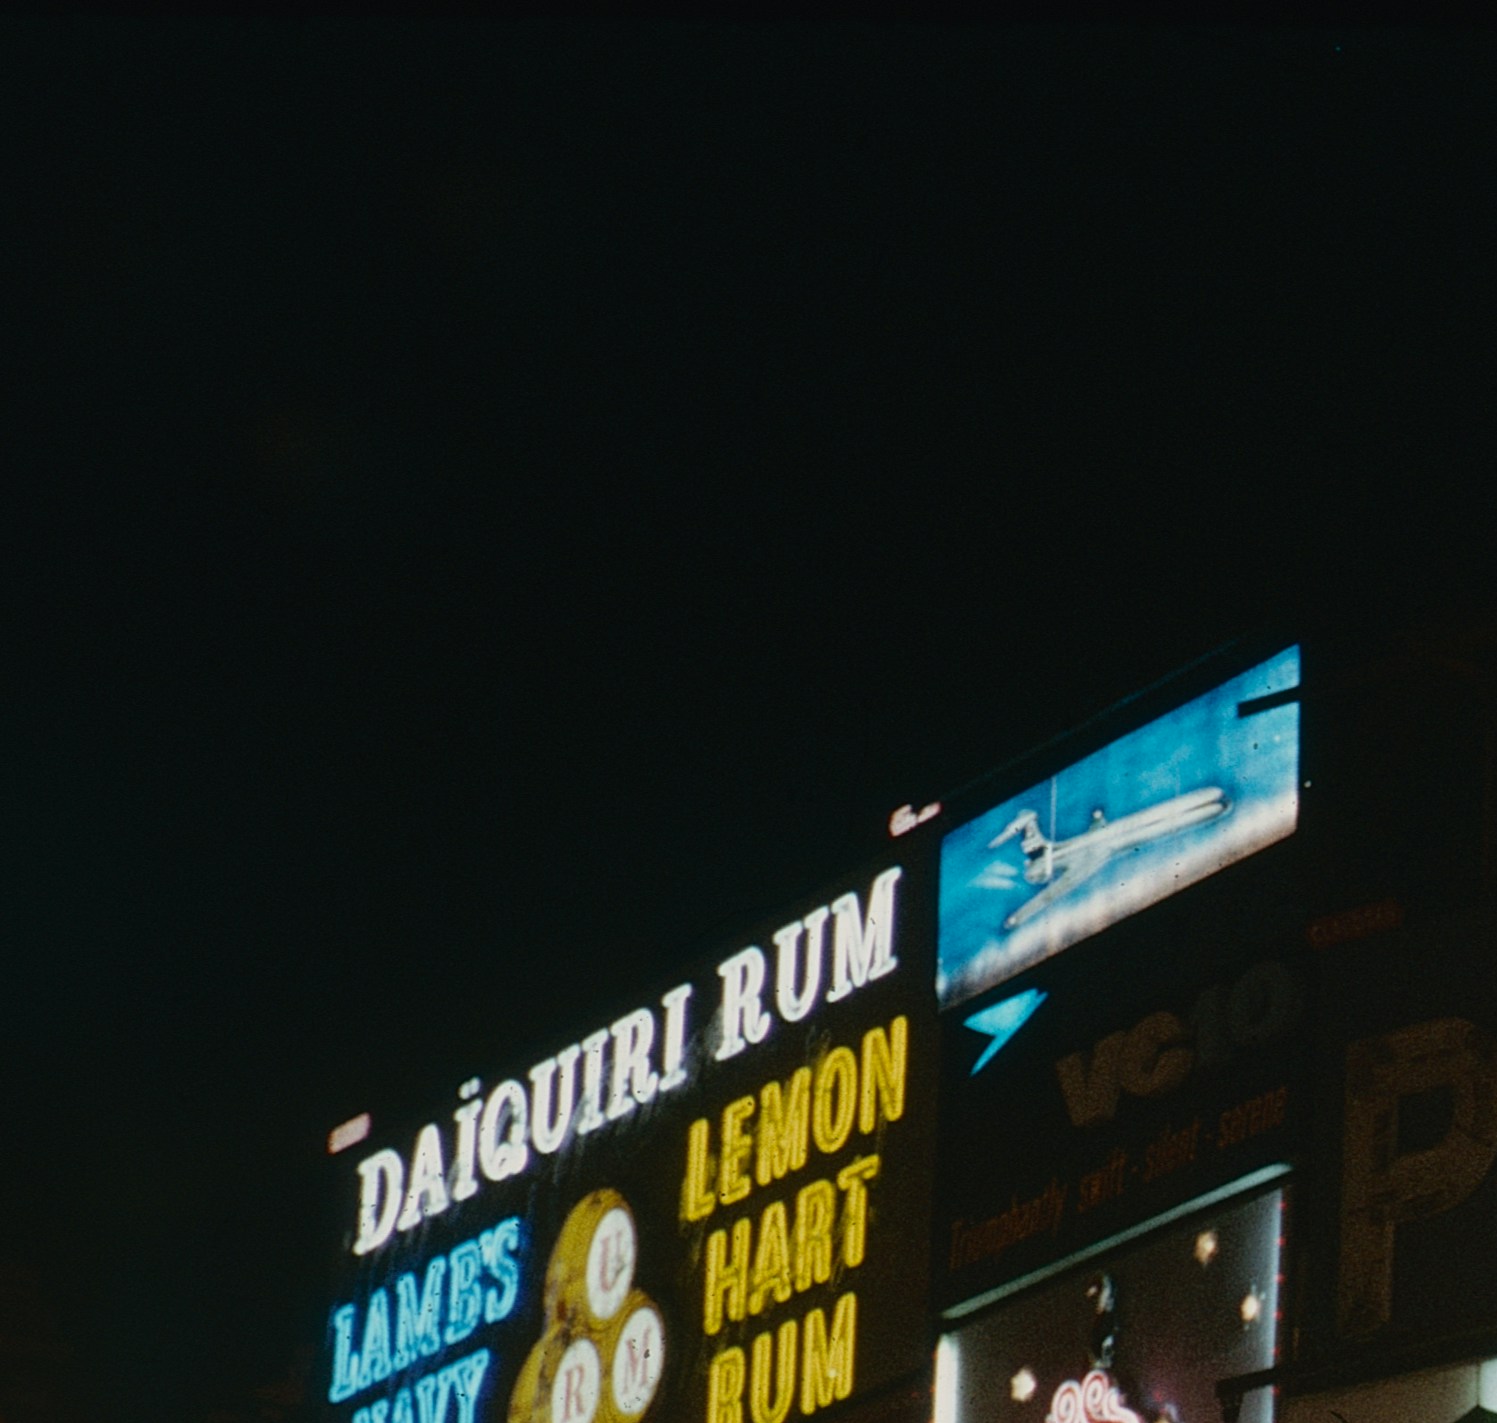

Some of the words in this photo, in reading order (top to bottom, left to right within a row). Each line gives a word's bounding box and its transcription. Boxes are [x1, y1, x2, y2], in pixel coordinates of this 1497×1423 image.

[715, 864, 904, 1062] RUM
[1054, 961, 1307, 1130] VC10
[681, 1013, 910, 1222] LEMON
[328, 1213, 522, 1403] LAMB'S
[703, 1154, 880, 1336] HART
